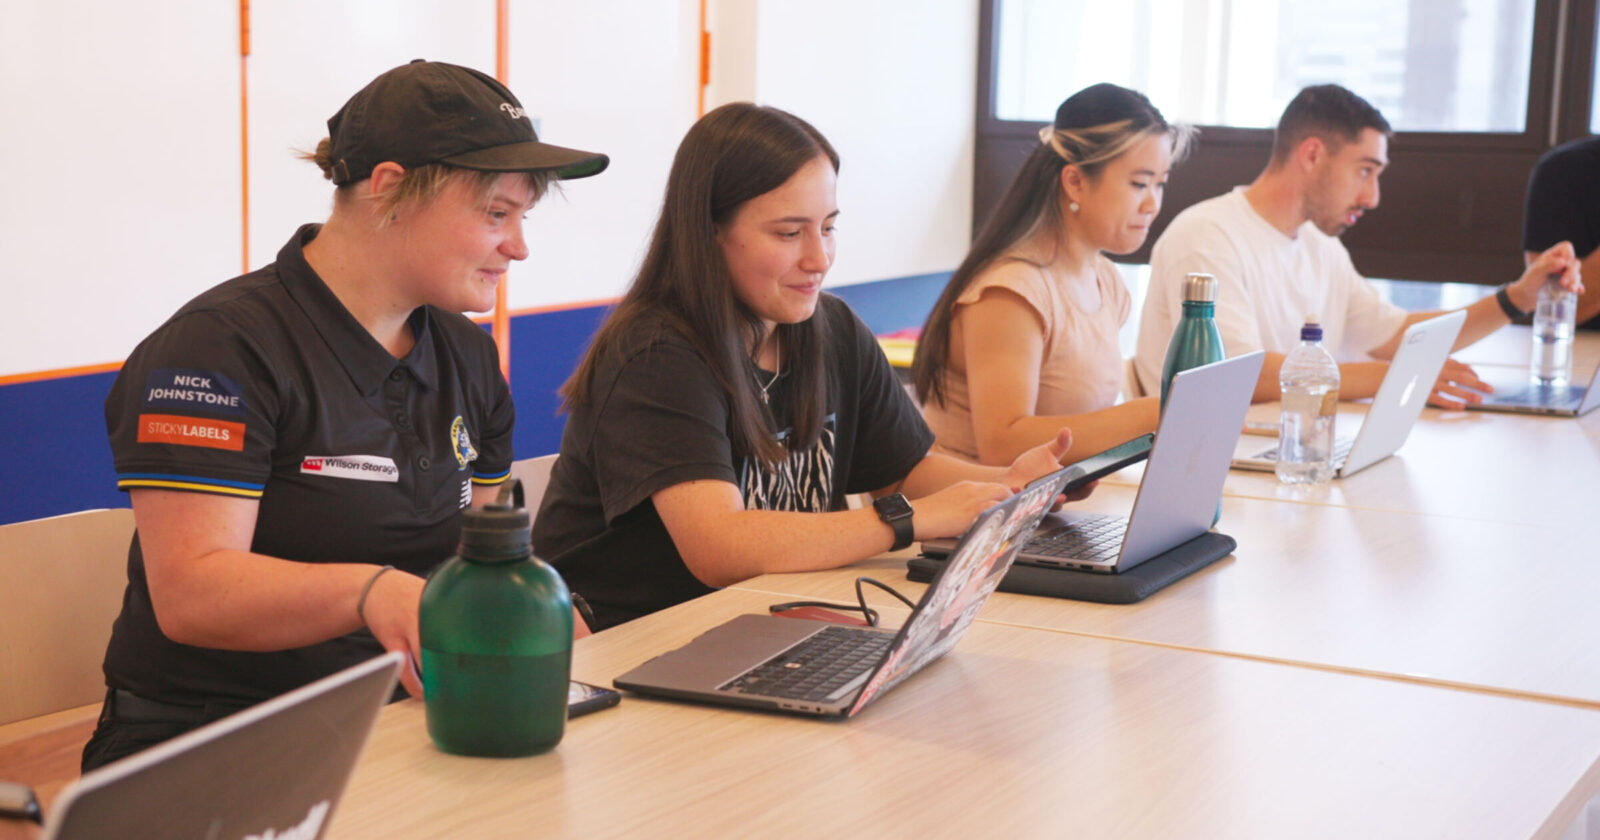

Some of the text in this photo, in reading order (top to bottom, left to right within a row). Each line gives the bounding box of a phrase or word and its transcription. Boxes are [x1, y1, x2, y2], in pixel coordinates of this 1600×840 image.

[174, 375, 211, 389] NICK
[148, 389, 239, 407] JOHNSTONE
[148, 422, 230, 441] STICKYLABELS
[325, 459, 359, 469] Wilson
